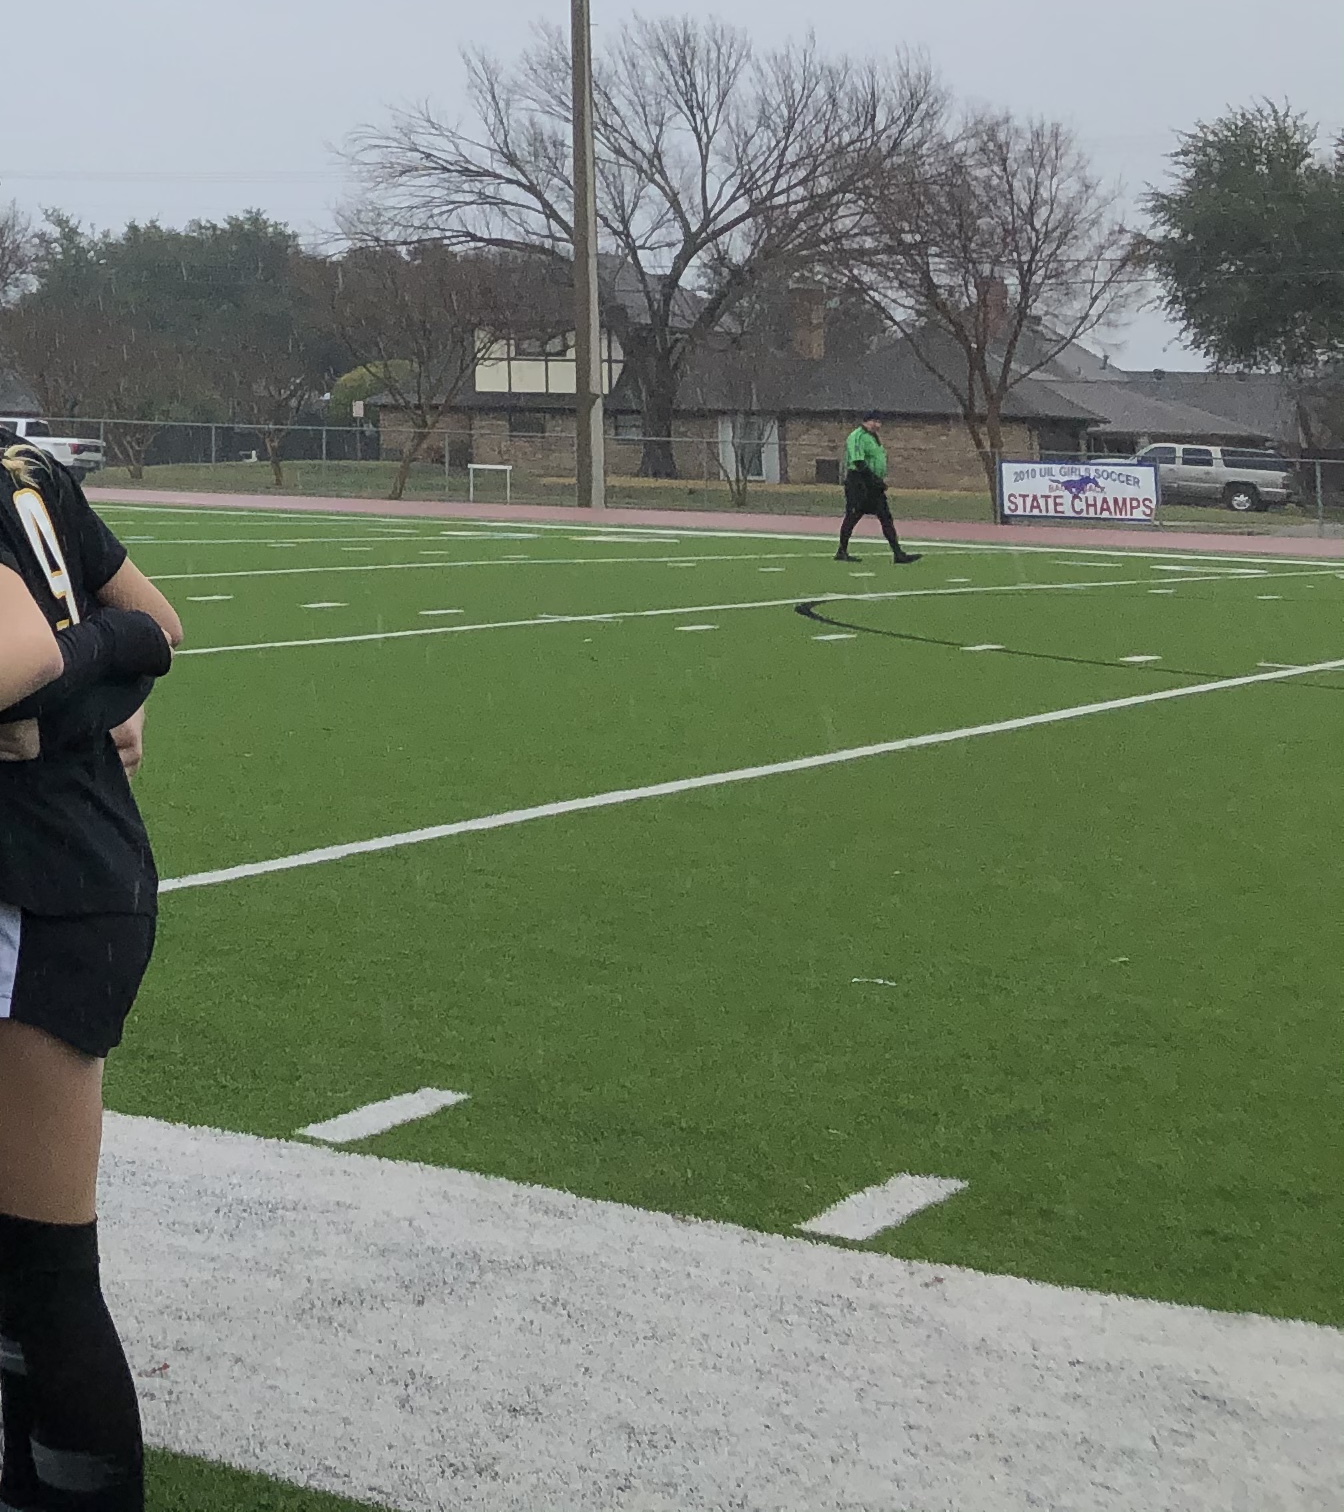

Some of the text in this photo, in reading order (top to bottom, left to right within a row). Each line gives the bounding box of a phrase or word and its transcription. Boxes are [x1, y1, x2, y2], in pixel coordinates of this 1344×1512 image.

[1039, 467, 1055, 478] UIL
[1094, 468, 1140, 488] SOCCER
[1007, 493, 1154, 517] STATE CHAMPS
